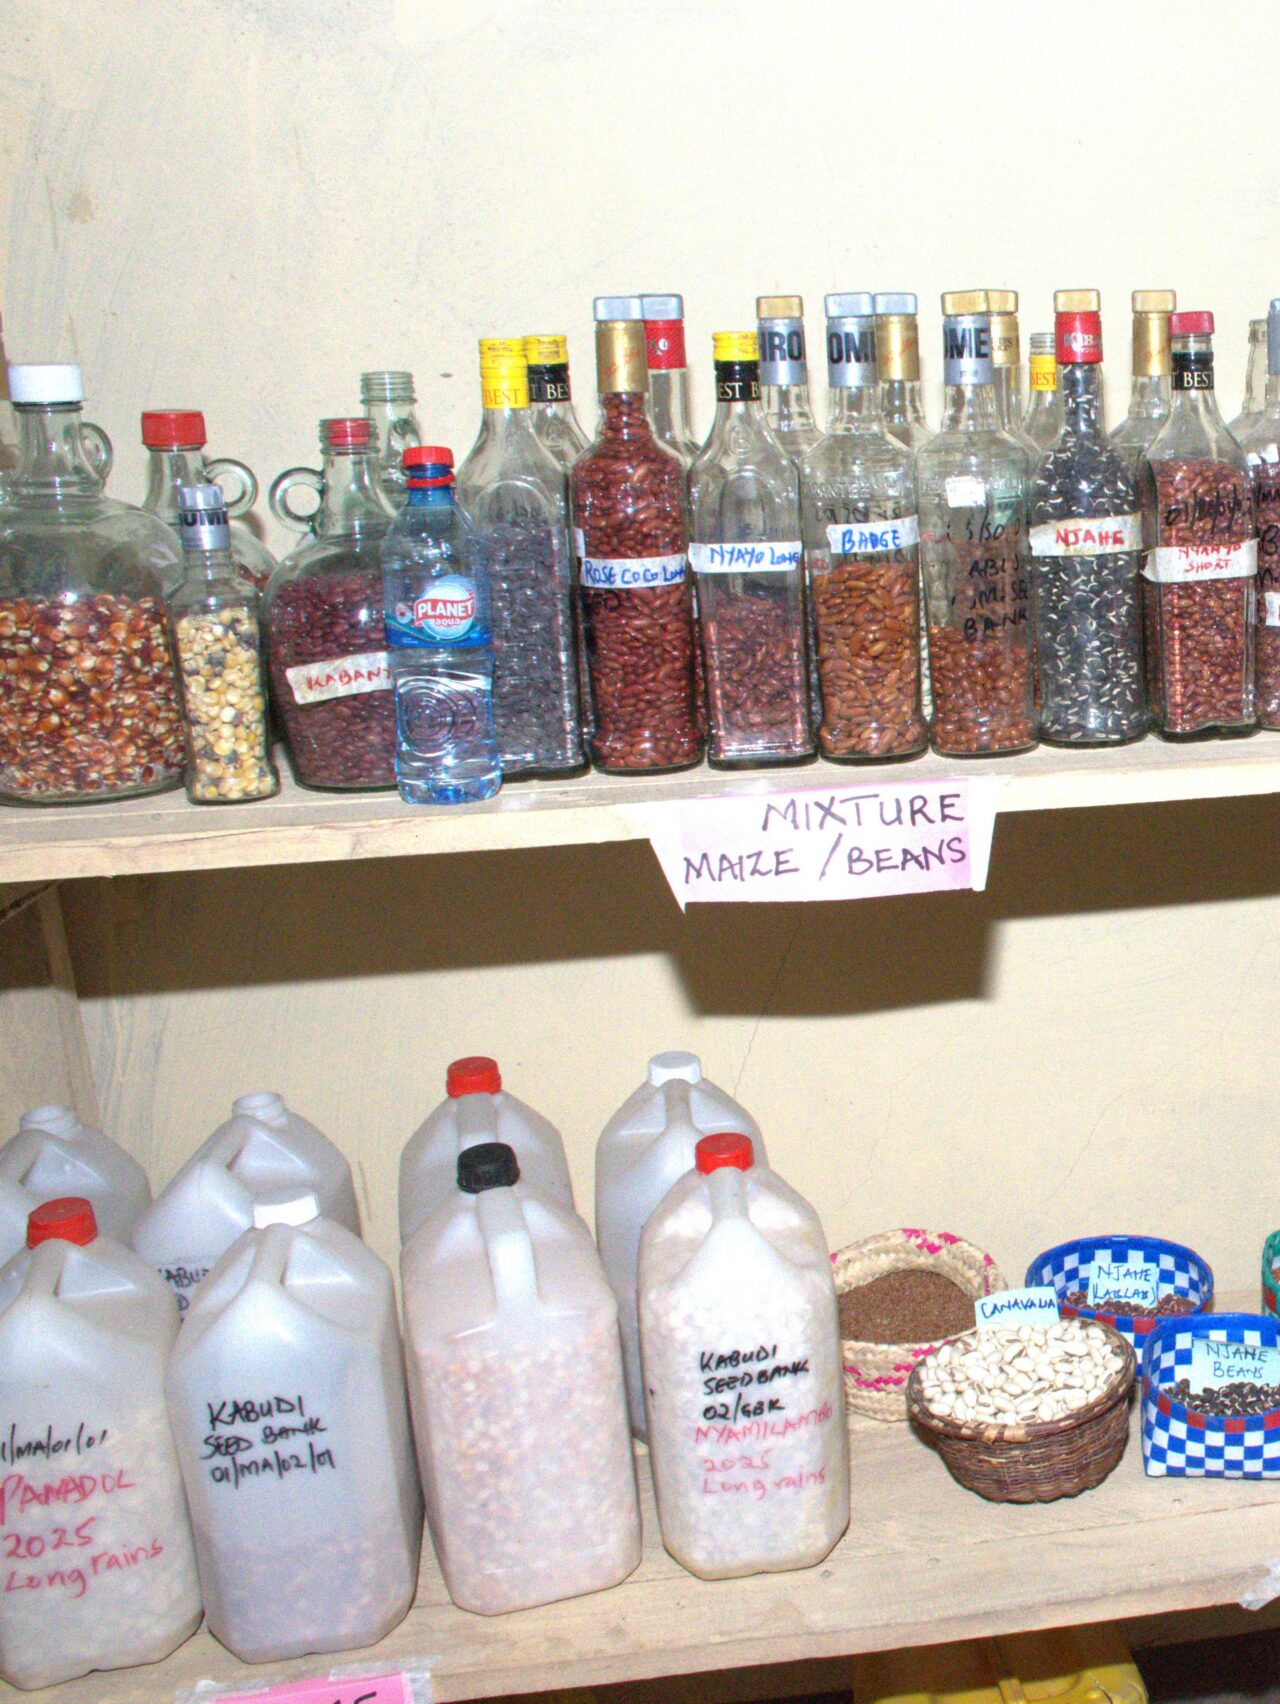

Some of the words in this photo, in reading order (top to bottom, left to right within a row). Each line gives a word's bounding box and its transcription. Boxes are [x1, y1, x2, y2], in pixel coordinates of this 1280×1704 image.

[484, 388, 522, 405] BEST
[719, 383, 743, 400] EST
[417, 600, 475, 618] PLANET
[434, 617, 461, 627] aqua
[761, 793, 965, 831] MIXTURE
[683, 848, 801, 884] MAIZE
[701, 1344, 778, 1373] KABUDI
[207, 1395, 306, 1432] KABUDI
[703, 1448, 774, 1473] 2025
[702, 1477, 767, 1501] Long
[3, 1516, 97, 1560] 2025
[3, 1568, 88, 1599] Long
[90, 1538, 165, 1576] rains
